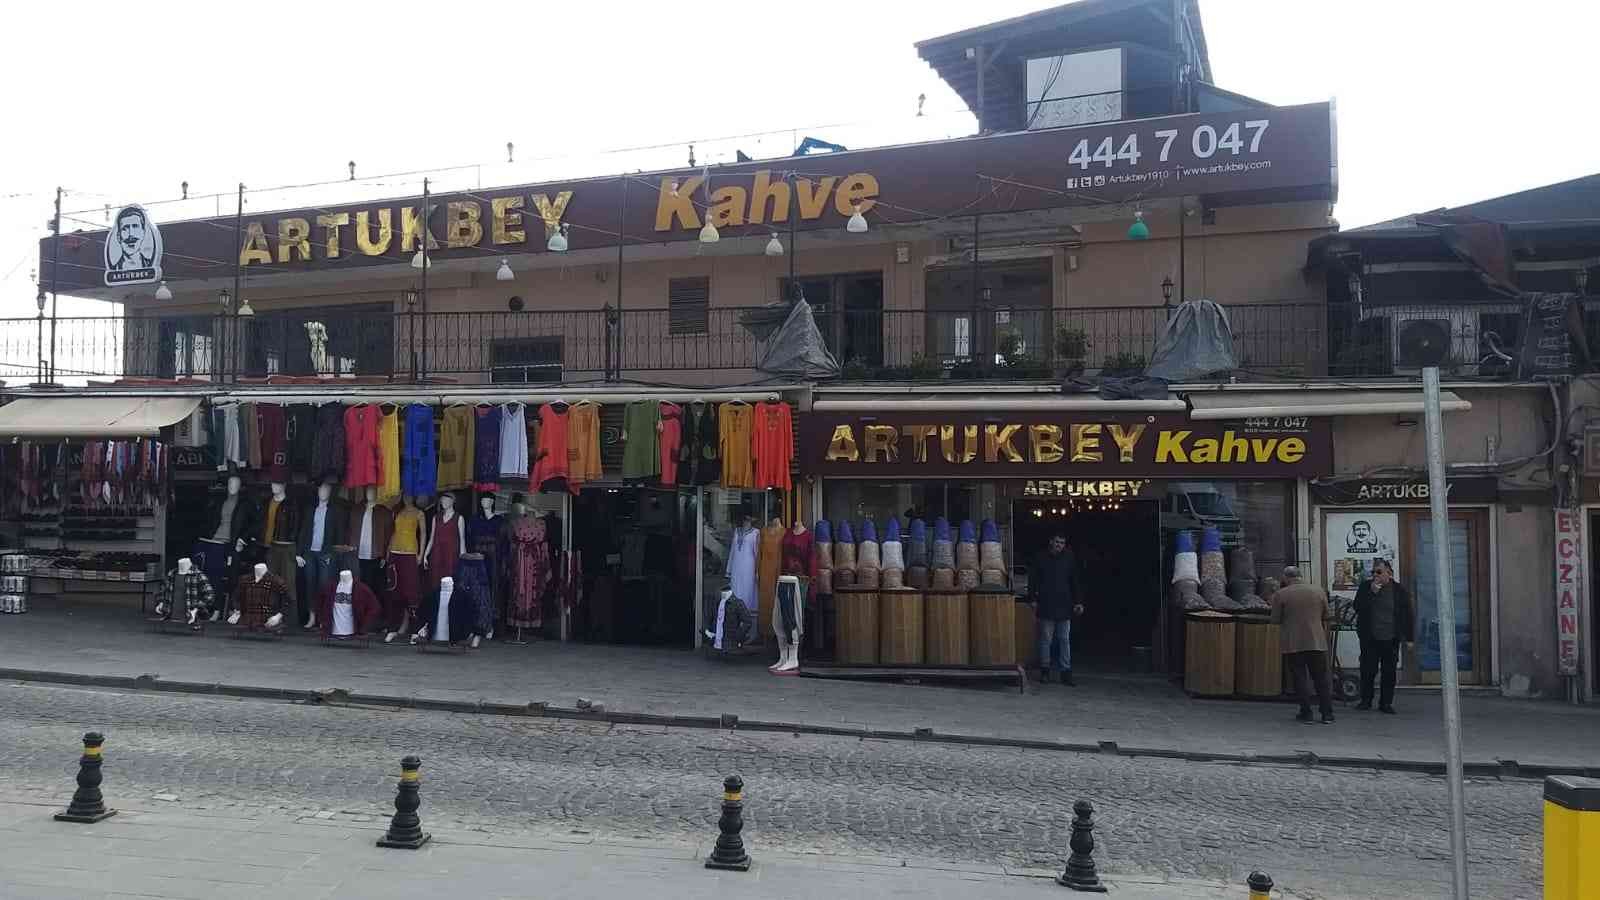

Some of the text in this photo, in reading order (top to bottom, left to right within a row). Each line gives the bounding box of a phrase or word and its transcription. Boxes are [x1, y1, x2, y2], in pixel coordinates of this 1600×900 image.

[1067, 119, 1270, 170] 444 7 047
[1183, 159, 1272, 177] www.artukbey.com
[239, 169, 880, 267] ARTUKBEY Kahve
[1245, 416, 1309, 428] 444 7 047
[824, 423, 1305, 464] ARTUKBEY Kahve
[1023, 479, 1143, 496] ARTUKBEY
[1357, 482, 1453, 499] ARTUKBY
